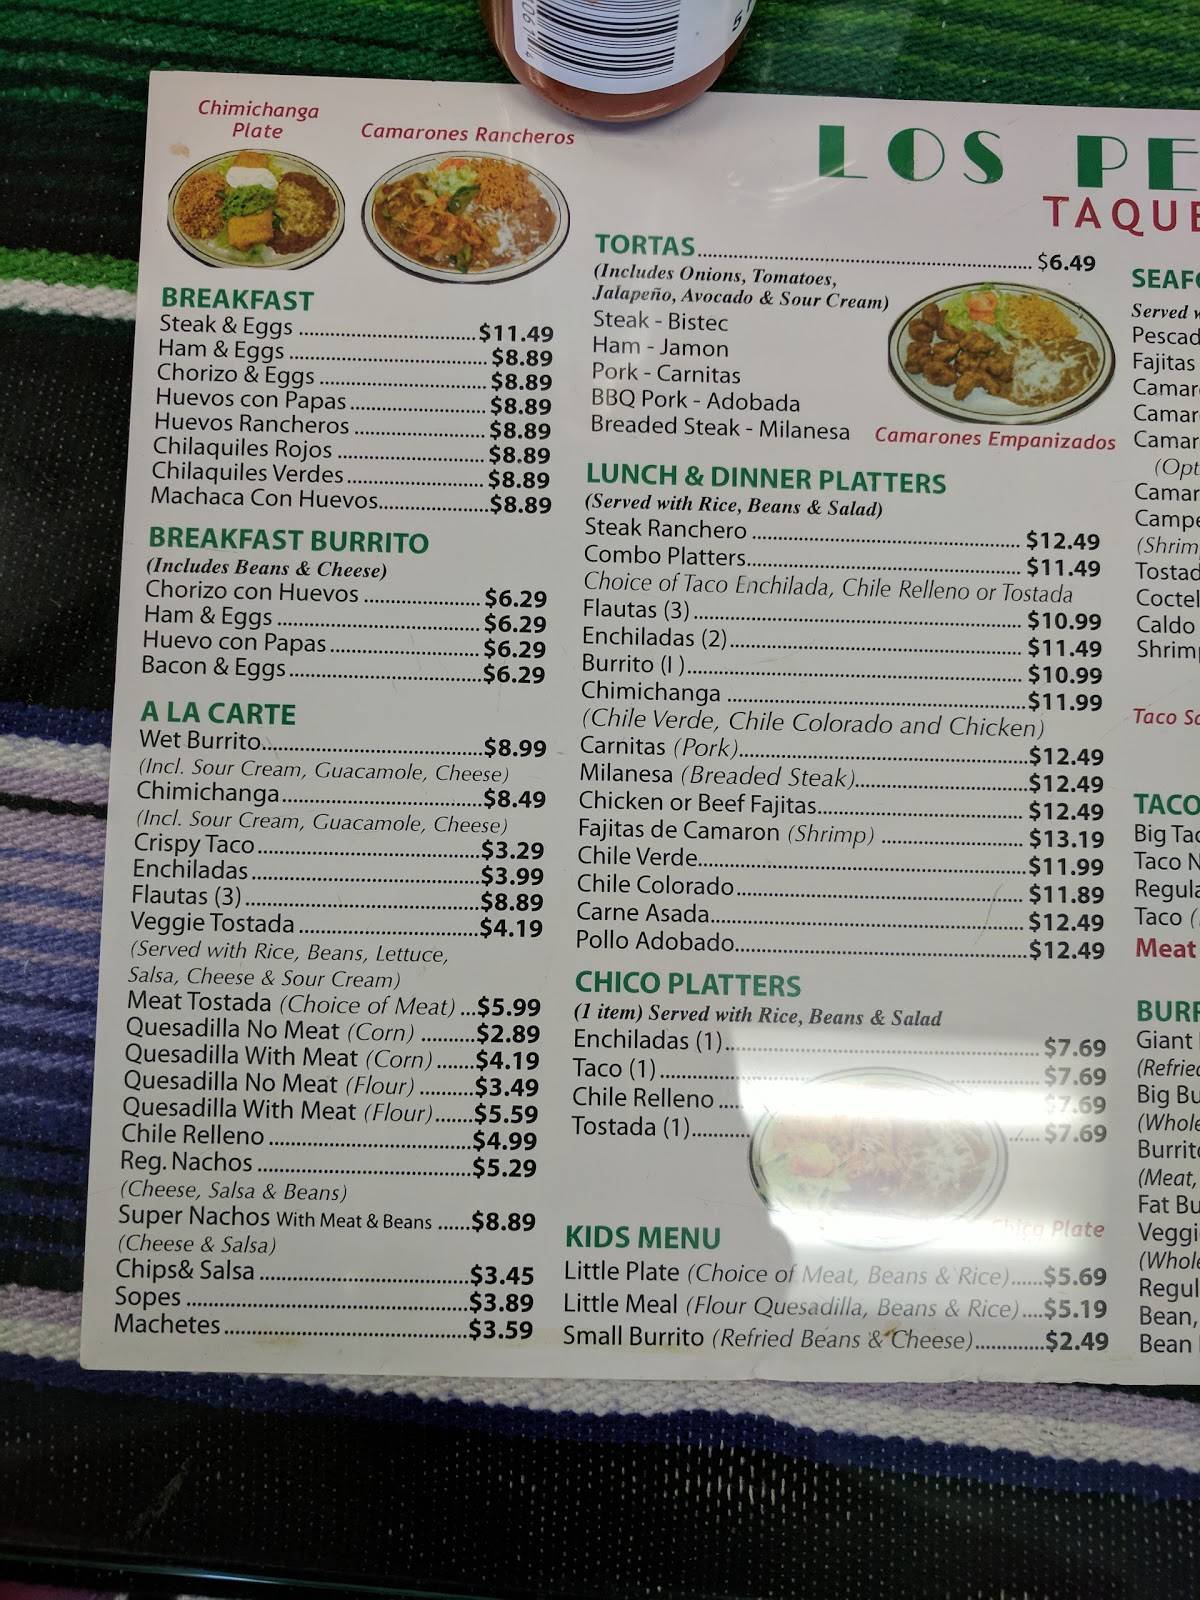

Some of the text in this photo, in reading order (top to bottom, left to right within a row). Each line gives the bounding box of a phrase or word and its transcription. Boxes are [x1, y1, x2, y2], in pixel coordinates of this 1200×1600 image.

[198, 100, 319, 122] Chimichanga
[232, 122, 283, 139] Plate
[361, 123, 575, 145] Camarones Rancheros
[819, 125, 1004, 184] LOS
[595, 233, 1096, 272] TORTAS $6.49
[594, 263, 837, 289] (Includes Onions, Tomatoes,
[162, 287, 315, 311] BREAKFAST
[592, 284, 889, 313] Jalapeño, Avocado & Sour Cream)
[160, 314, 554, 343] Steak & Eggs $11.49
[159, 338, 553, 368] Ham & Eggs $8.89
[1133, 352, 1195, 375] Fajitas
[157, 362, 552, 392] Chorizo & Eggs $8.89
[156, 387, 552, 416] Huevos con Papas $8.89
[153, 435, 551, 465] Chilaquiles Rojos $8.89
[875, 426, 1116, 451] Camarones Empanizados
[587, 462, 946, 495] LUNCH & DINNER PLATTERS
[149, 526, 429, 554] BREAKFAST BURRITO
[585, 517, 1100, 551] Steak Ranchero $12.49
[146, 557, 387, 582] (Includes Beans & Cheese)
[584, 544, 1101, 578] Combo Platters $11.49
[146, 578, 547, 609] Chorizo con Huevos $6.29
[1137, 615, 1195, 635] Caldo
[583, 626, 1102, 658] Enchiladas (2) $11.49
[142, 655, 545, 685] Bacon & Eggs $6.29
[581, 680, 1103, 712] Chimichanga $11.99
[140, 700, 296, 726] A LA CARTE
[139, 729, 547, 759] Wet Burrito $8.99
[580, 735, 1104, 767] Carnitas (Pork) $12.49
[139, 757, 509, 784] (Incl. Sour Cream, Guacamole, Cheese)
[579, 789, 1104, 822] Chicken or Beef Fajitas $12.49
[134, 832, 544, 861] Crispy Taco $3.29
[579, 818, 1104, 850] Fajitas de Camaron (Shrimp) $13.19
[132, 883, 544, 913] Flautas (3) $8.89
[577, 873, 1104, 905] Chile Colorado $11.89
[130, 910, 543, 939] Veggie Tostada $4.19
[577, 901, 1104, 933] Carne Asada $12.49
[577, 929, 1105, 961] Pollo Adobado $12.49
[1136, 938, 1196, 959] Meat
[575, 970, 801, 997] CHICO PLATTERS
[128, 990, 541, 1019] Meat Tostada (Choice of Meat) $5.99
[574, 1028, 1106, 1058] Enchiladas (1) $7.69
[1136, 1030, 1193, 1050] Giant
[122, 1122, 537, 1152] Chile Relleno $4.99
[571, 1115, 1107, 1144] Tostada (1) $7.69
[118, 1204, 536, 1233] Super Nachos With Meat & Beans $8.89
[566, 1225, 720, 1250] KIDS MENU
[115, 1285, 534, 1314] Sopes $3.89
[114, 1312, 533, 1341] Machetes $3.59
[563, 1324, 1109, 1353] Small Burrito (Refried Beans & Cheese) $2.49
